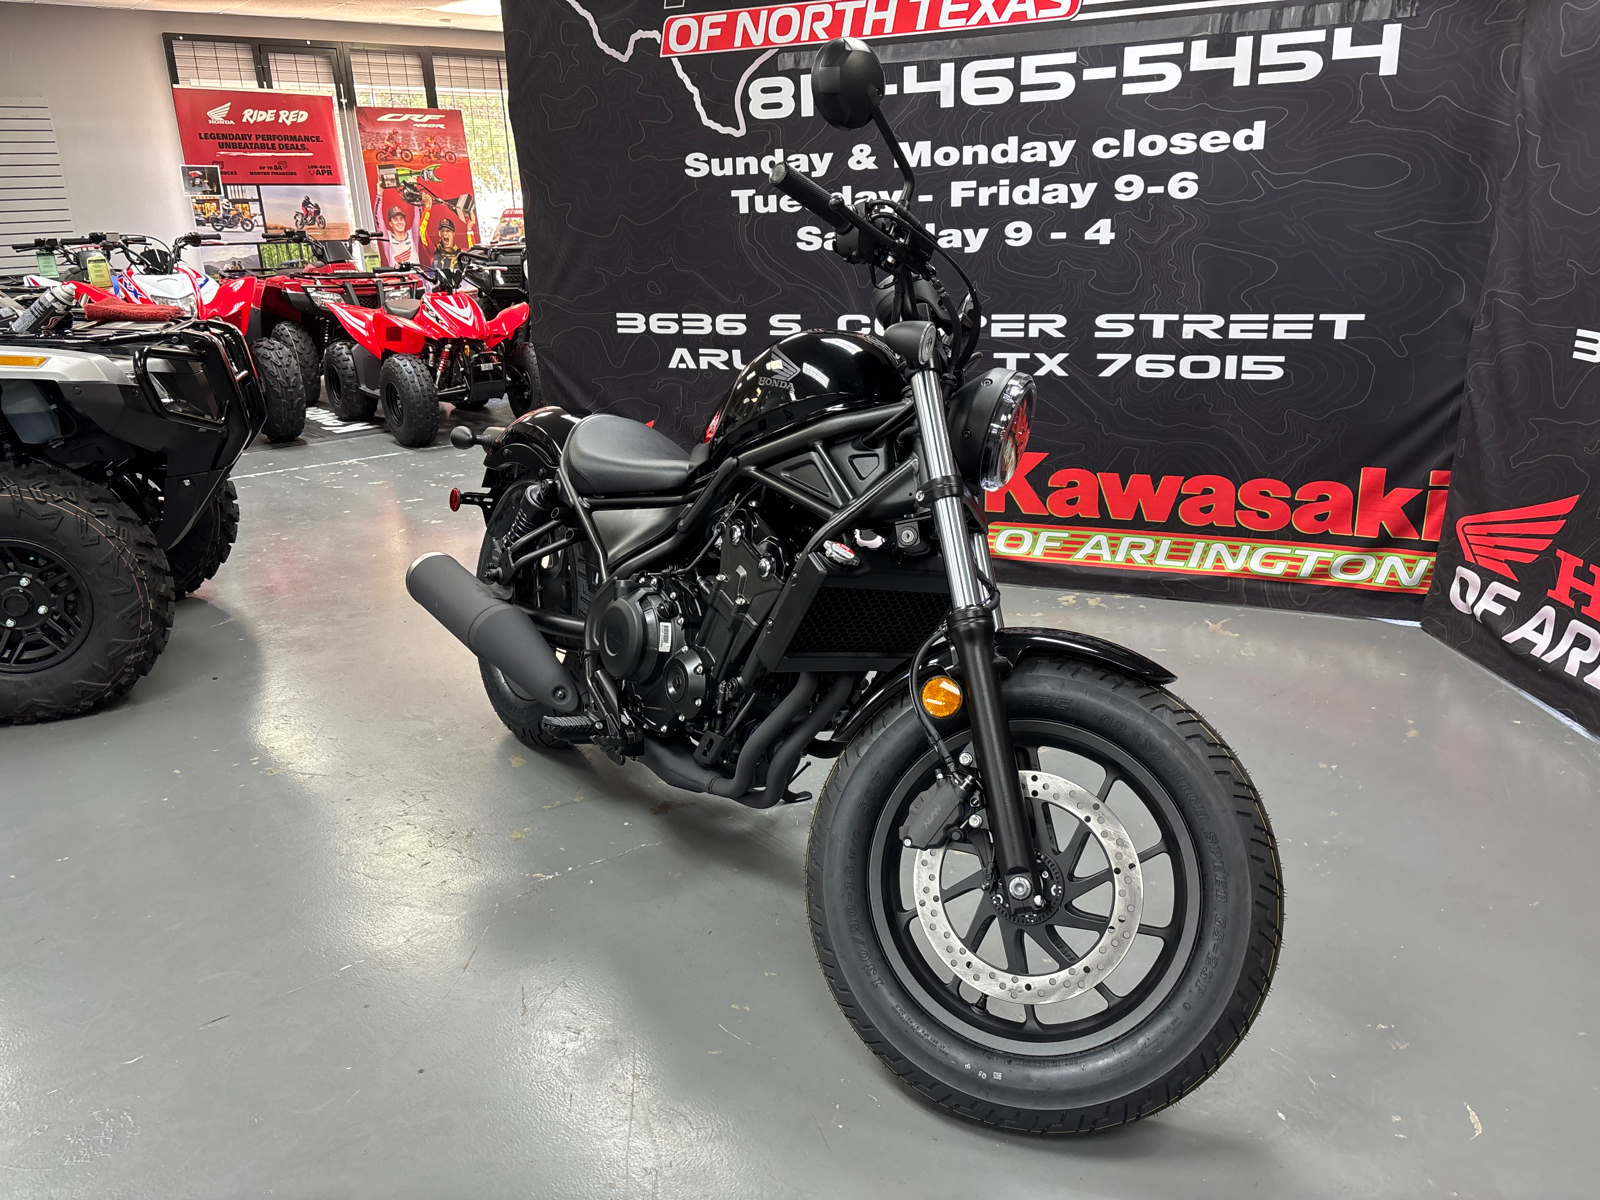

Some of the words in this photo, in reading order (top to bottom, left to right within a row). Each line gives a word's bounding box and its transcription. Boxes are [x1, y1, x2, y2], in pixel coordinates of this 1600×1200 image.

[668, 14, 727, 53] OF
[734, 0, 895, 47] NORTH
[908, 0, 1073, 30] TEXAS
[748, 23, 1402, 120] 81-465-5454
[242, 108, 277, 124] RIDE
[278, 109, 309, 126] RED
[377, 113, 445, 122] CRF
[198, 132, 252, 141] LEGENDARY
[255, 134, 323, 143] PERFORMANCE.
[217, 142, 276, 150] UNBEATABLE
[684, 147, 834, 178] Sunday
[847, 143, 878, 171] &
[894, 136, 1077, 169] Monday
[1092, 120, 1266, 159] closed
[951, 178, 1097, 209] Friday
[1114, 171, 1199, 201] 9-6
[1004, 221, 1033, 247] 9
[1084, 218, 1116, 245] 4
[616, 312, 747, 335] 3636
[1094, 313, 1366, 340] STREET
[993, 352, 1070, 377] TX
[1097, 353, 1286, 381] 76015
[758, 377, 795, 391] HONDA
[984, 452, 1451, 541] Kawasaki
[994, 529, 1069, 556] OF
[1074, 536, 1431, 588] ARLINGTON
[1449, 565, 1521, 623] OF
[1204, 830, 1228, 904] SPEED
